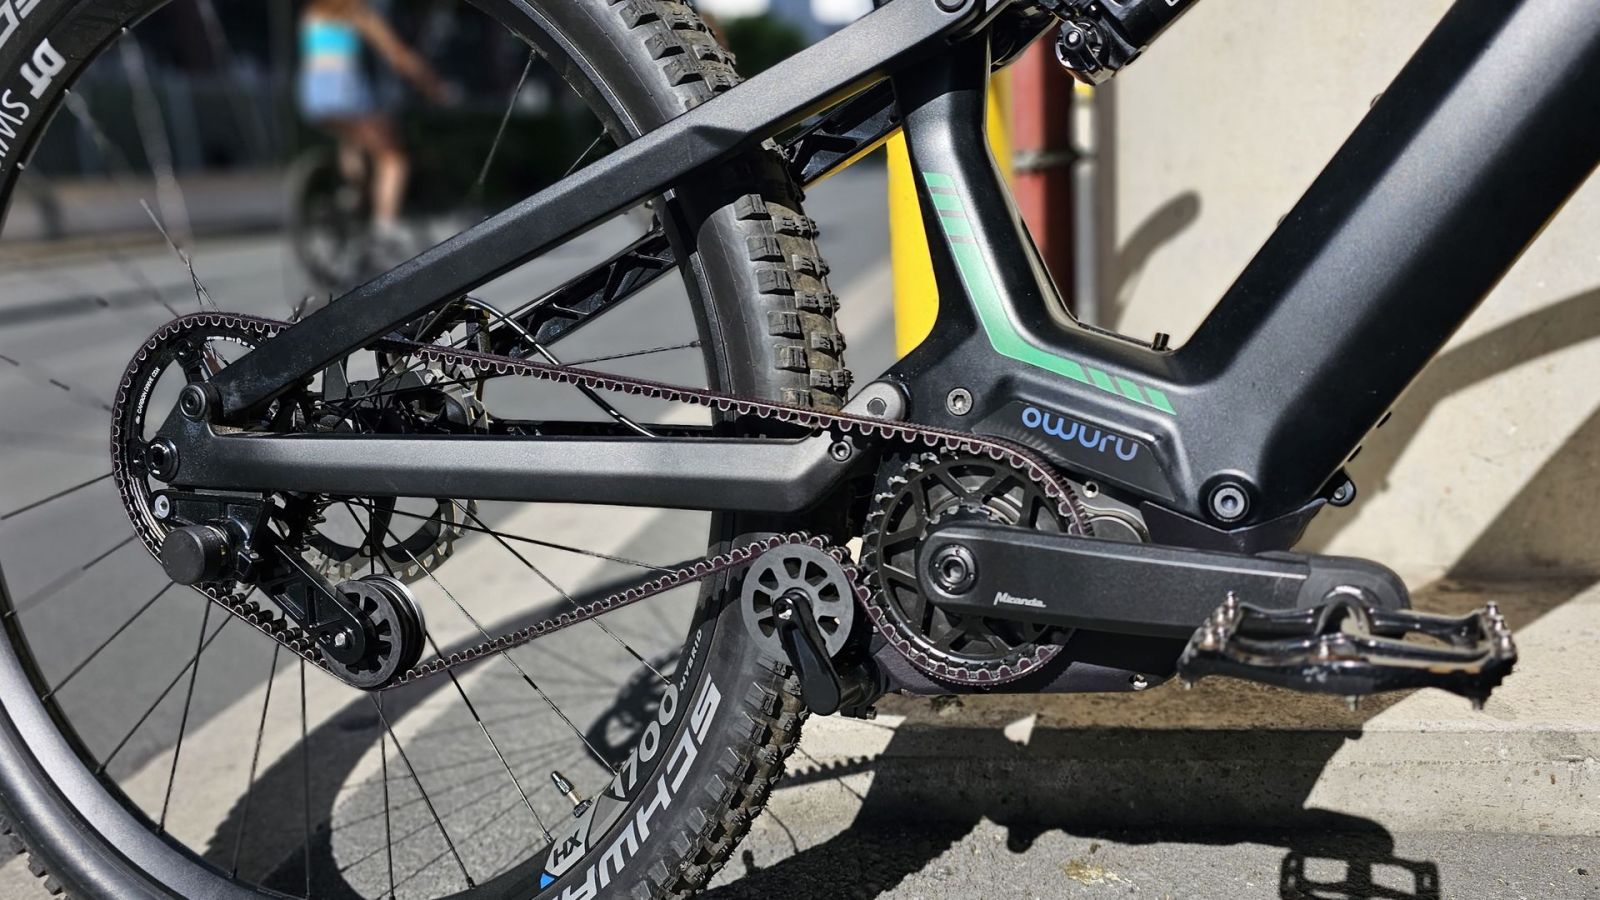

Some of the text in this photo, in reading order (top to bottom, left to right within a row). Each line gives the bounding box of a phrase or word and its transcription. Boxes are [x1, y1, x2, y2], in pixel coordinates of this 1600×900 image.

[20, 38, 66, 99] DT
[0, 88, 30, 158] SW
[1021, 407, 1139, 461] owuru
[553, 628, 702, 868] HX 1700 HYBRID
[551, 672, 722, 900] SCHWA
